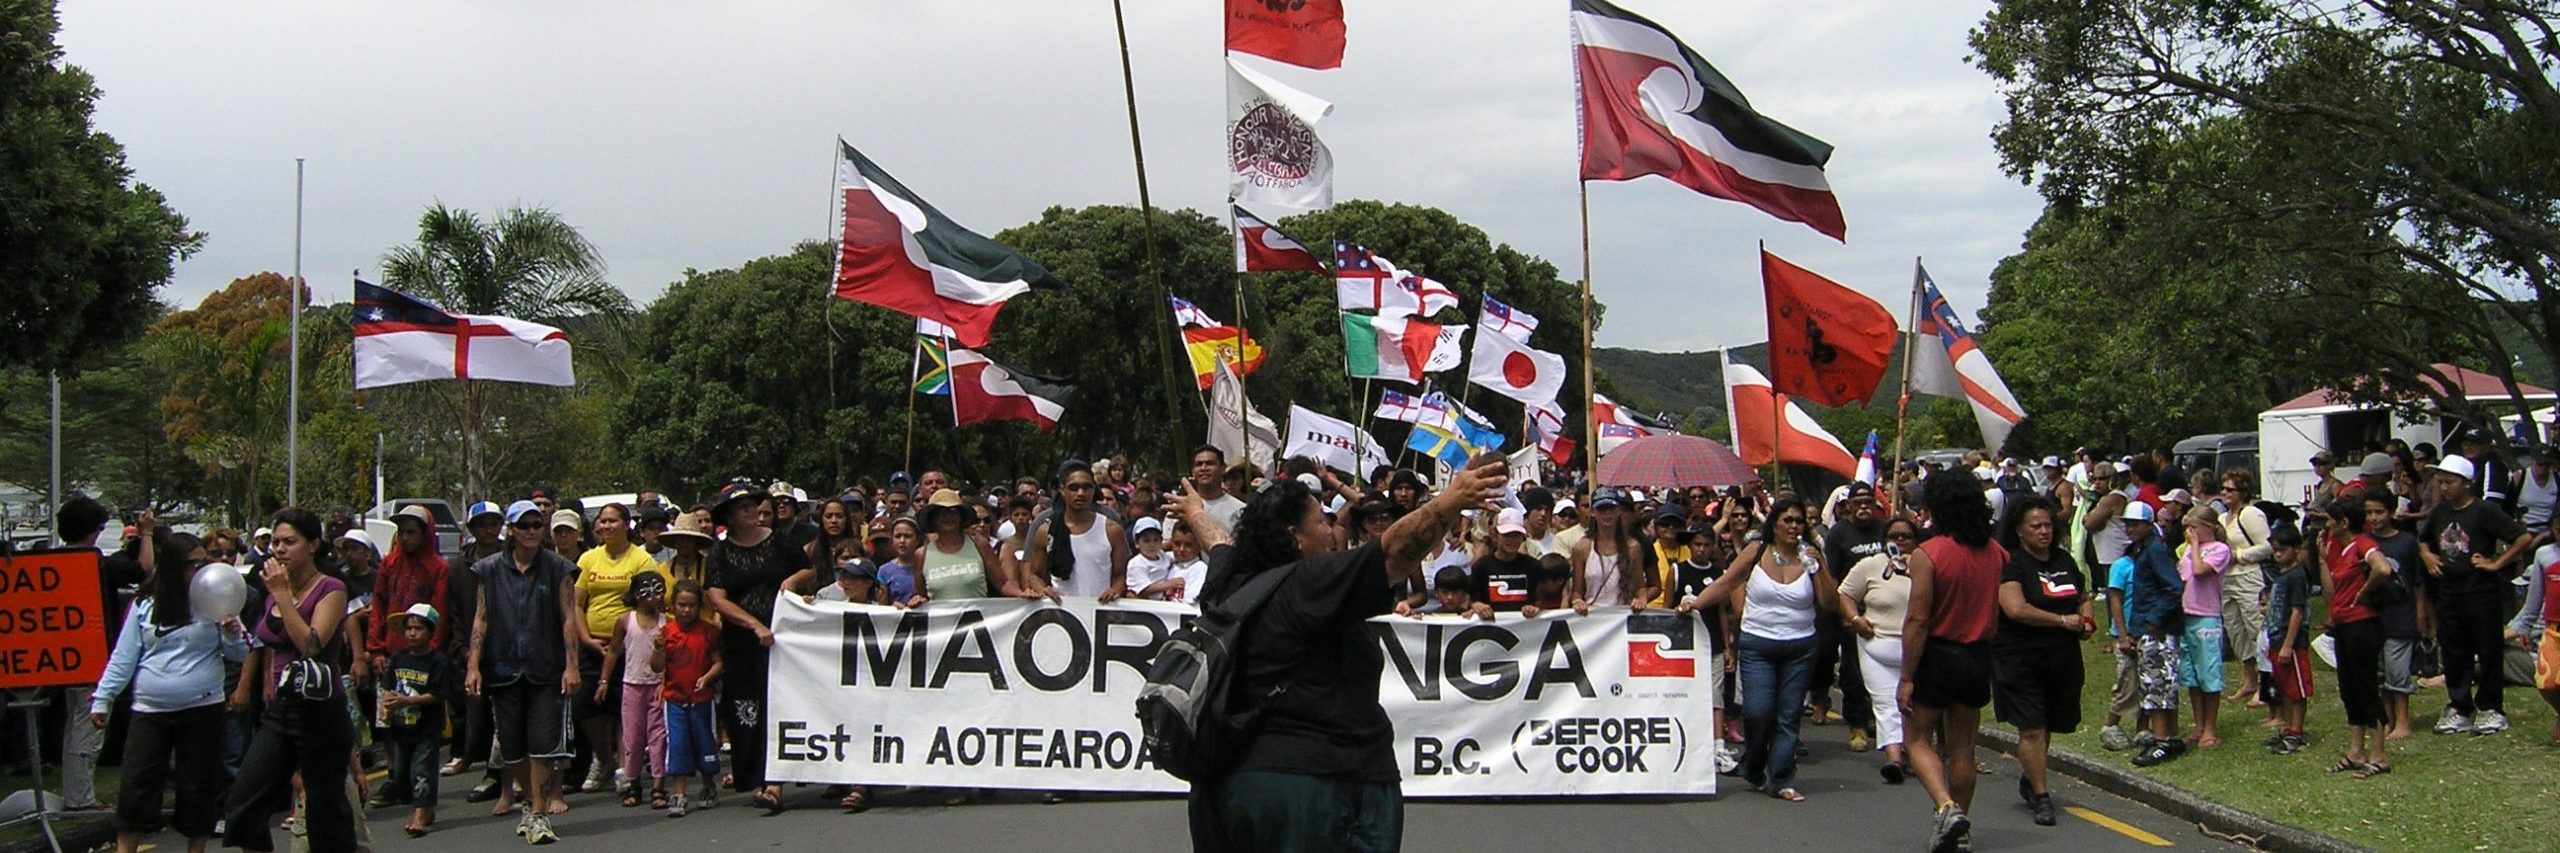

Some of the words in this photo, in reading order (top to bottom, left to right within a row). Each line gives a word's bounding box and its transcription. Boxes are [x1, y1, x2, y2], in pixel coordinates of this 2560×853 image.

[1234, 106, 1269, 165] HONOUR
[841, 608, 1198, 694] MAOR
[778, 721, 852, 763] Est
[872, 724, 905, 764] in
[926, 726, 1162, 770] AOTEAROA
[1414, 737, 1491, 775] B.C.
